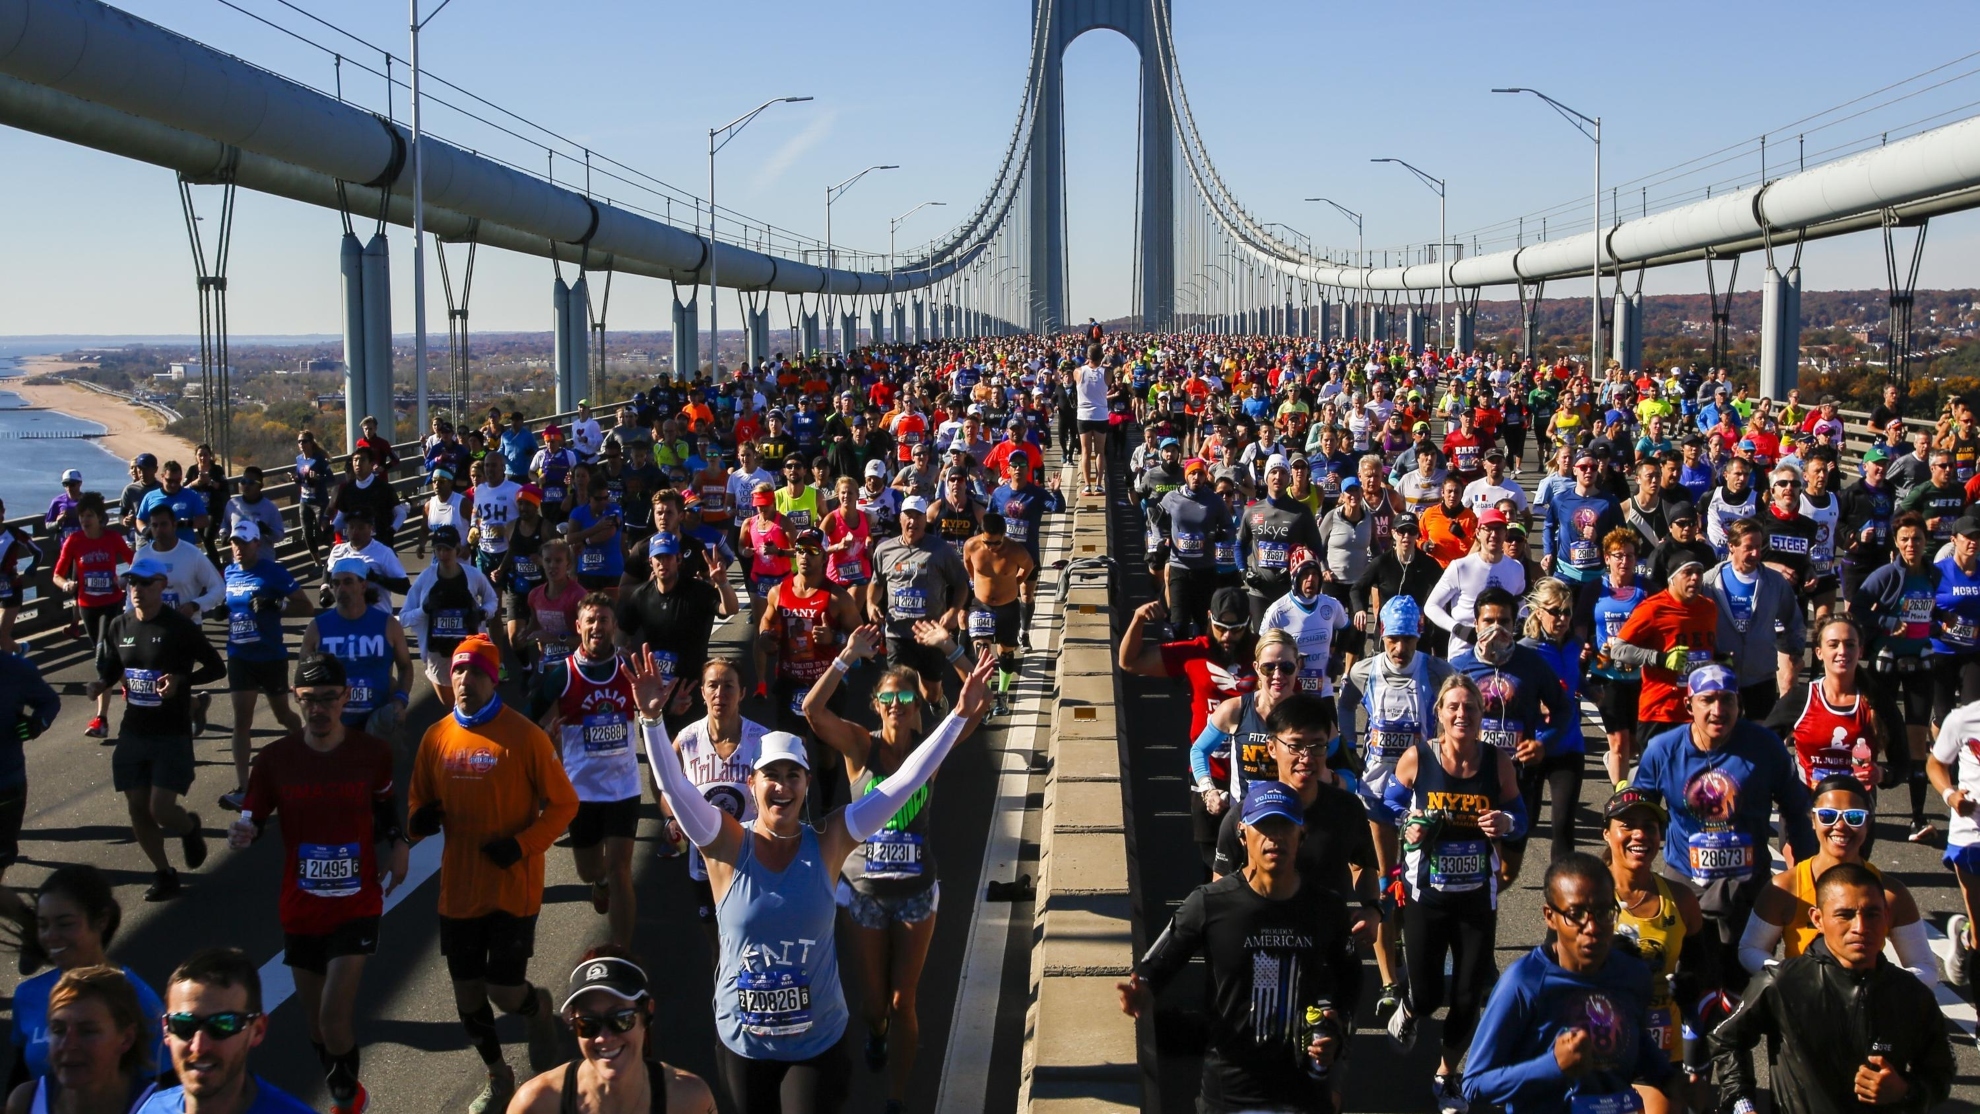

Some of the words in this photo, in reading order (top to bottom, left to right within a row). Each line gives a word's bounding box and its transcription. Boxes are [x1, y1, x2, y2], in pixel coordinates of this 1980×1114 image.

[1455, 446, 1480, 455] BART
[1929, 498, 1961, 507] JETS
[941, 518, 971, 529] NYPD
[1258, 521, 1289, 539] skye
[1772, 537, 1806, 551] SIEGE
[1263, 550, 1284, 560] 28687
[1952, 586, 1980, 596] MORG
[1909, 599, 1932, 611] 26307
[782, 608, 817, 619] DANY
[1604, 611, 1621, 619] New
[440, 618, 460, 628] 21167
[131, 680, 153, 693] 20574
[582, 688, 627, 712] ITALIA
[1380, 732, 1412, 747] 28267
[1810, 755, 1822, 764] ST.
[1824, 756, 1844, 766] JUDE
[1427, 791, 1490, 813] NYPD
[879, 844, 909, 861] 21231
[1440, 855, 1478, 873] 33059
[1701, 850, 1743, 868] 28673
[311, 860, 348, 878] 21495
[1243, 936, 1313, 948] AMERICAN
[740, 996, 745, 1007] 2
[748, 990, 800, 1012] 20826
[1872, 1042, 1892, 1052] GORE
